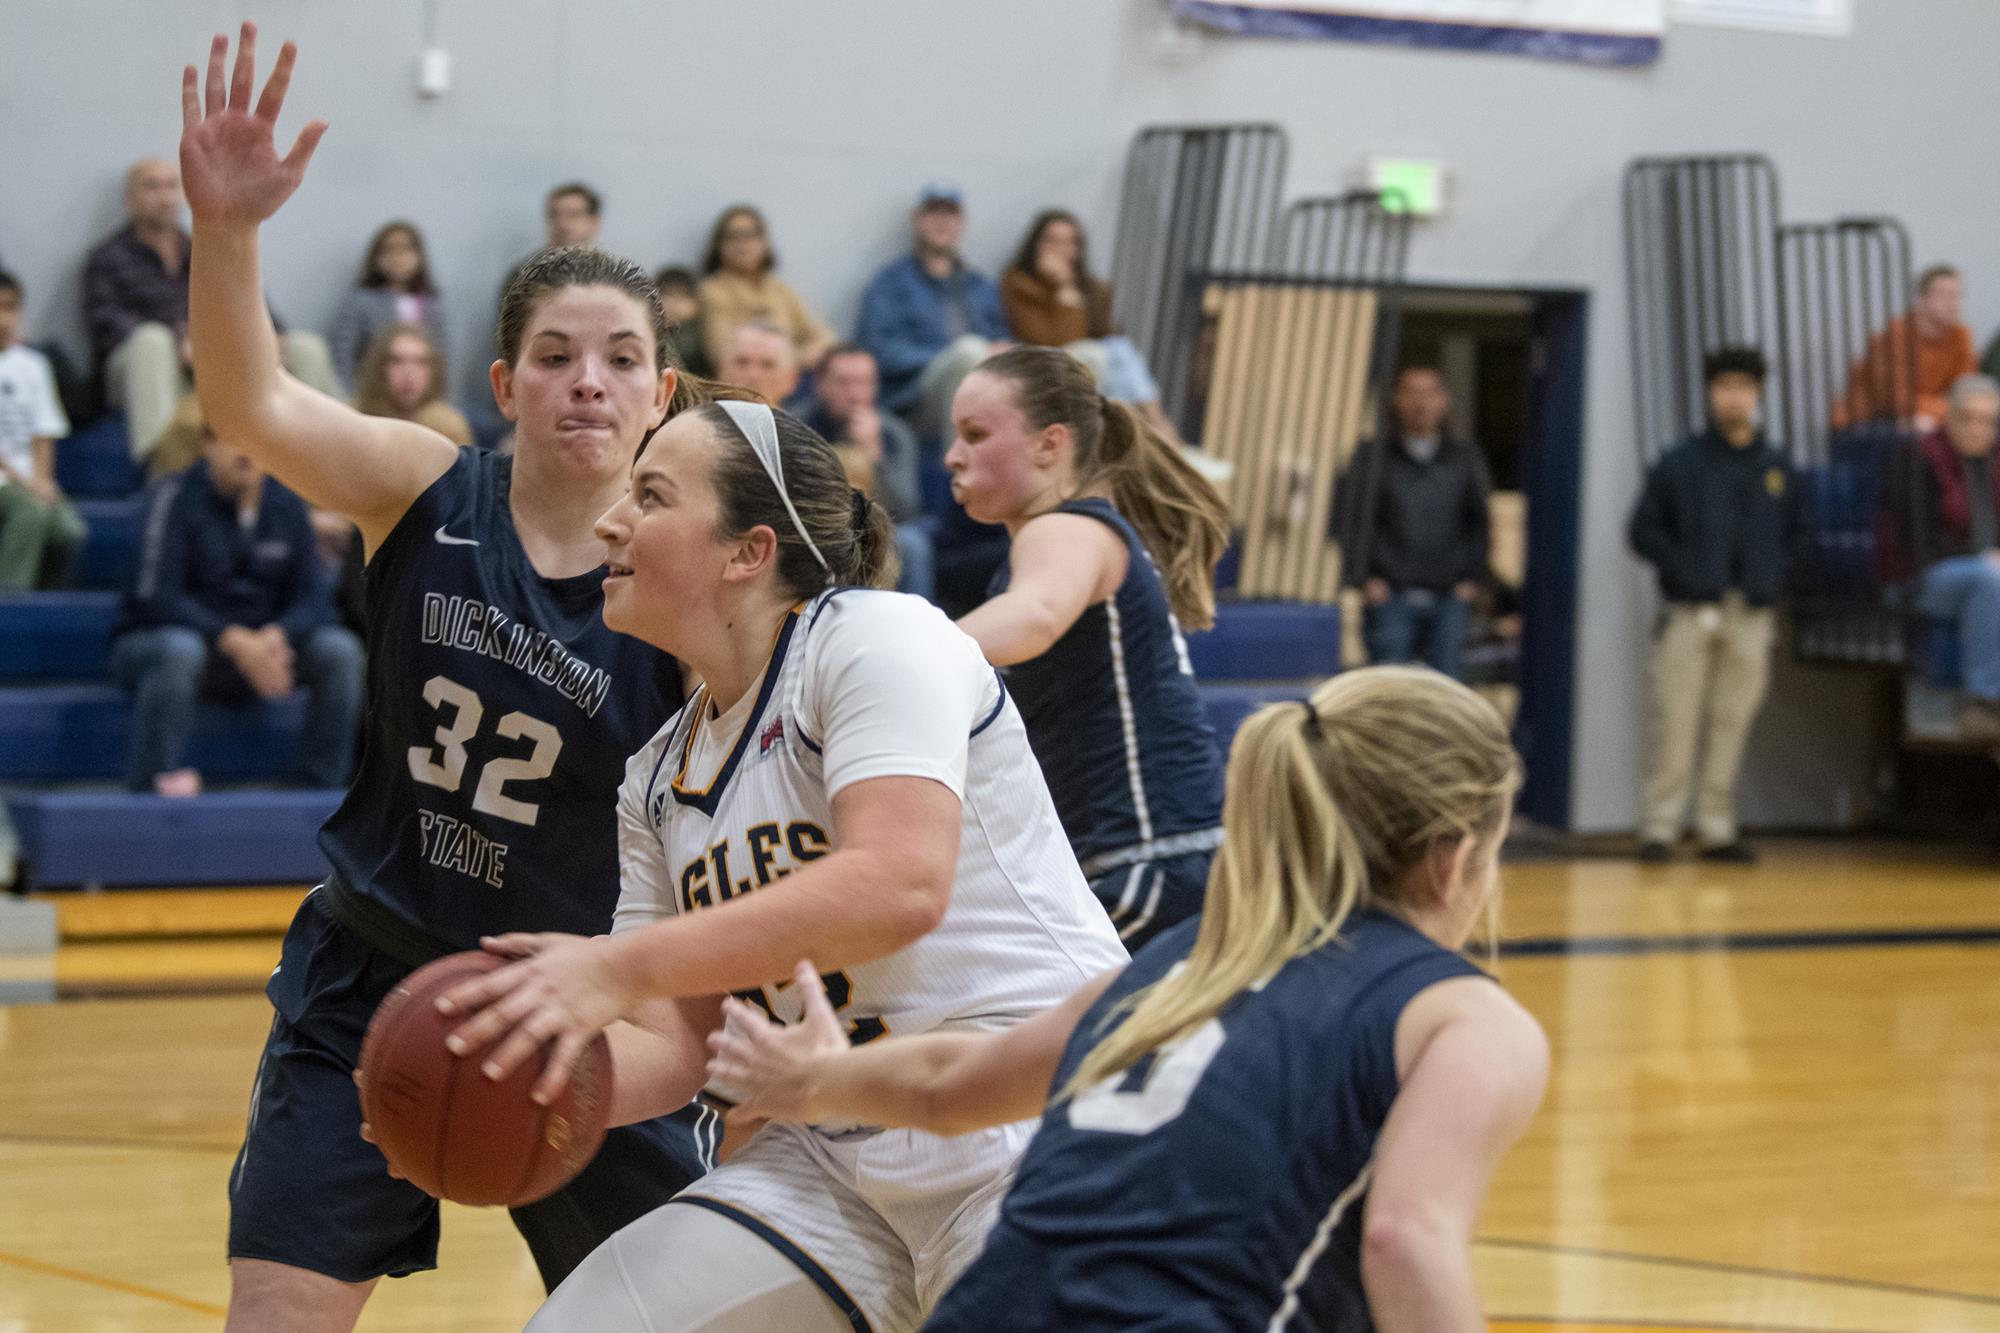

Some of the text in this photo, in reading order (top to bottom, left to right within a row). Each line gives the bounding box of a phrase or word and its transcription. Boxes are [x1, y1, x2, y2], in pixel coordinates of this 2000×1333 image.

[421, 592, 612, 719] DICKINSON
[407, 675, 563, 826] 32
[417, 808, 509, 889] STATE
